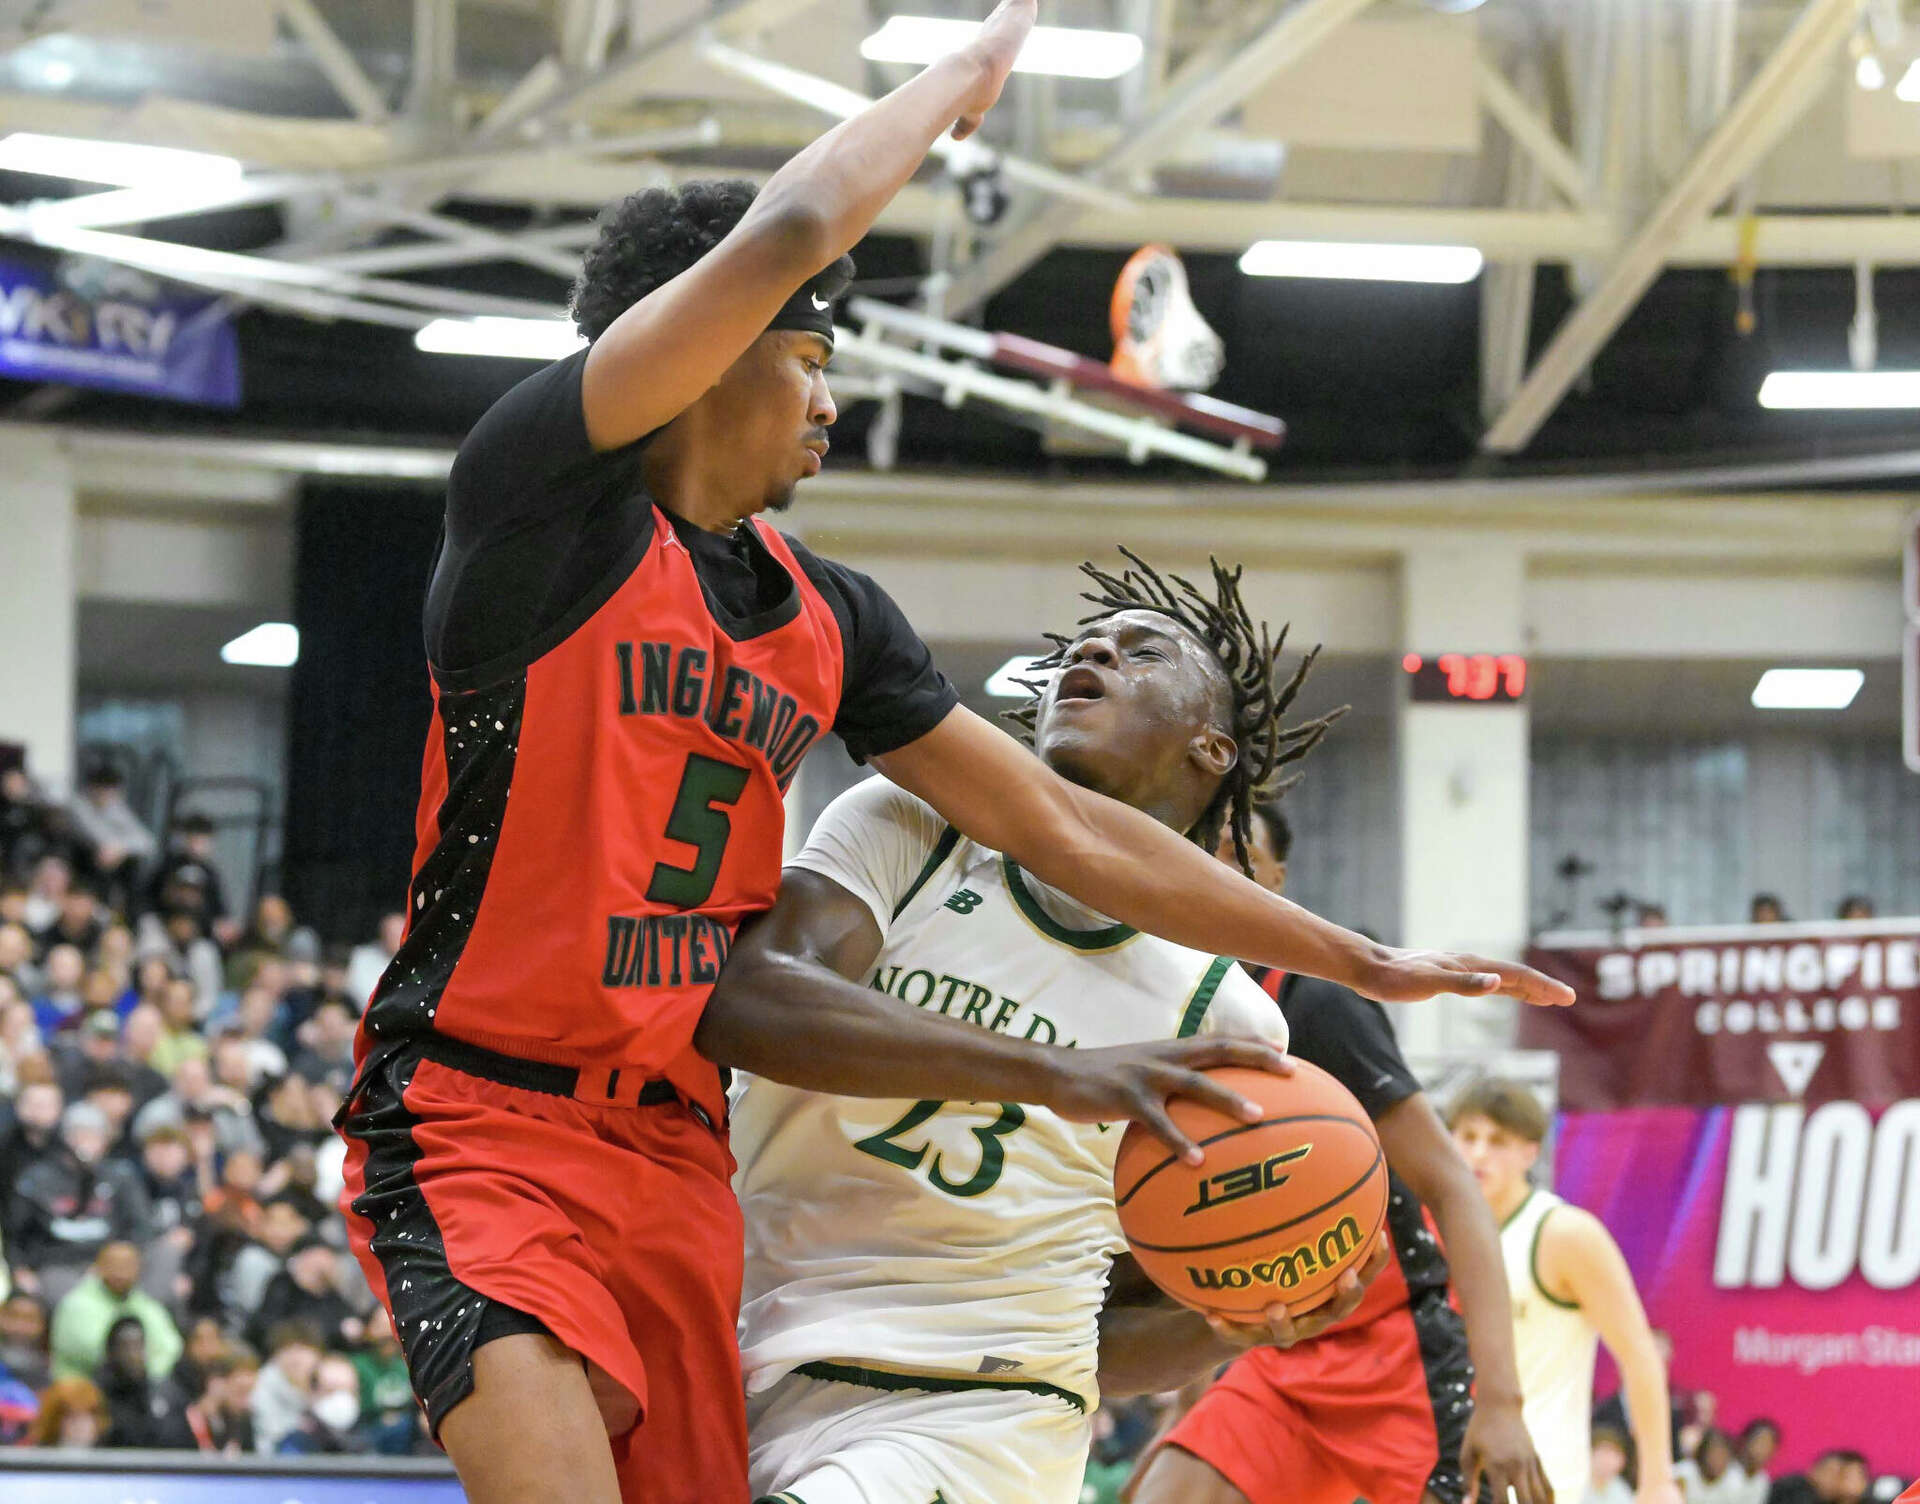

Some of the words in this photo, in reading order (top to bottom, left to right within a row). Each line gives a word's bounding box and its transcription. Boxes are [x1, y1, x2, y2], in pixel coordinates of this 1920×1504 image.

[646, 752, 752, 909] 5
[853, 1098, 1026, 1197] 23
[1183, 1143, 1313, 1217] JET
[1713, 1102, 1920, 1291] HOO
[1185, 1212, 1364, 1290] Wilson
[1733, 1326, 1859, 1376] Morgan
